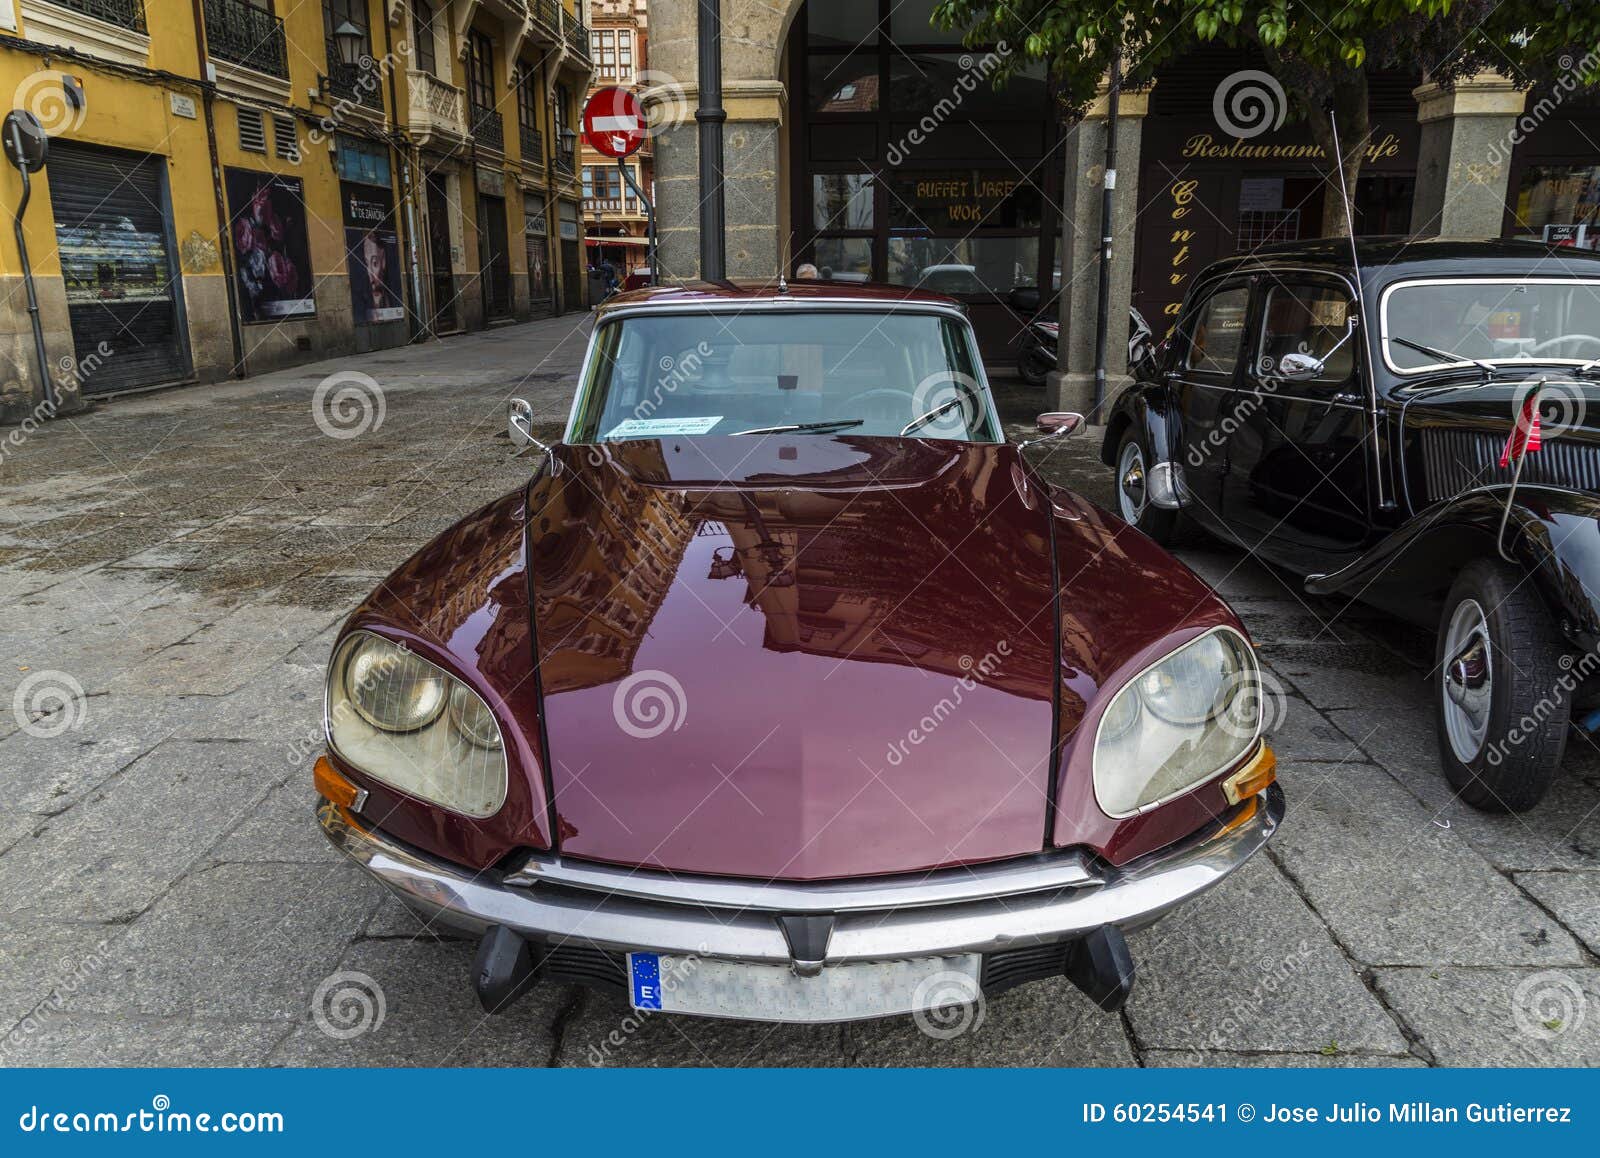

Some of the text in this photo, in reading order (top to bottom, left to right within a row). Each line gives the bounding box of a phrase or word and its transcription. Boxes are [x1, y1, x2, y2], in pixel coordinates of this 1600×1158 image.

[1362, 134, 1401, 163] afé
[916, 181, 968, 198] BUFFET
[948, 204, 982, 221] WOK
[641, 986, 653, 999] E
